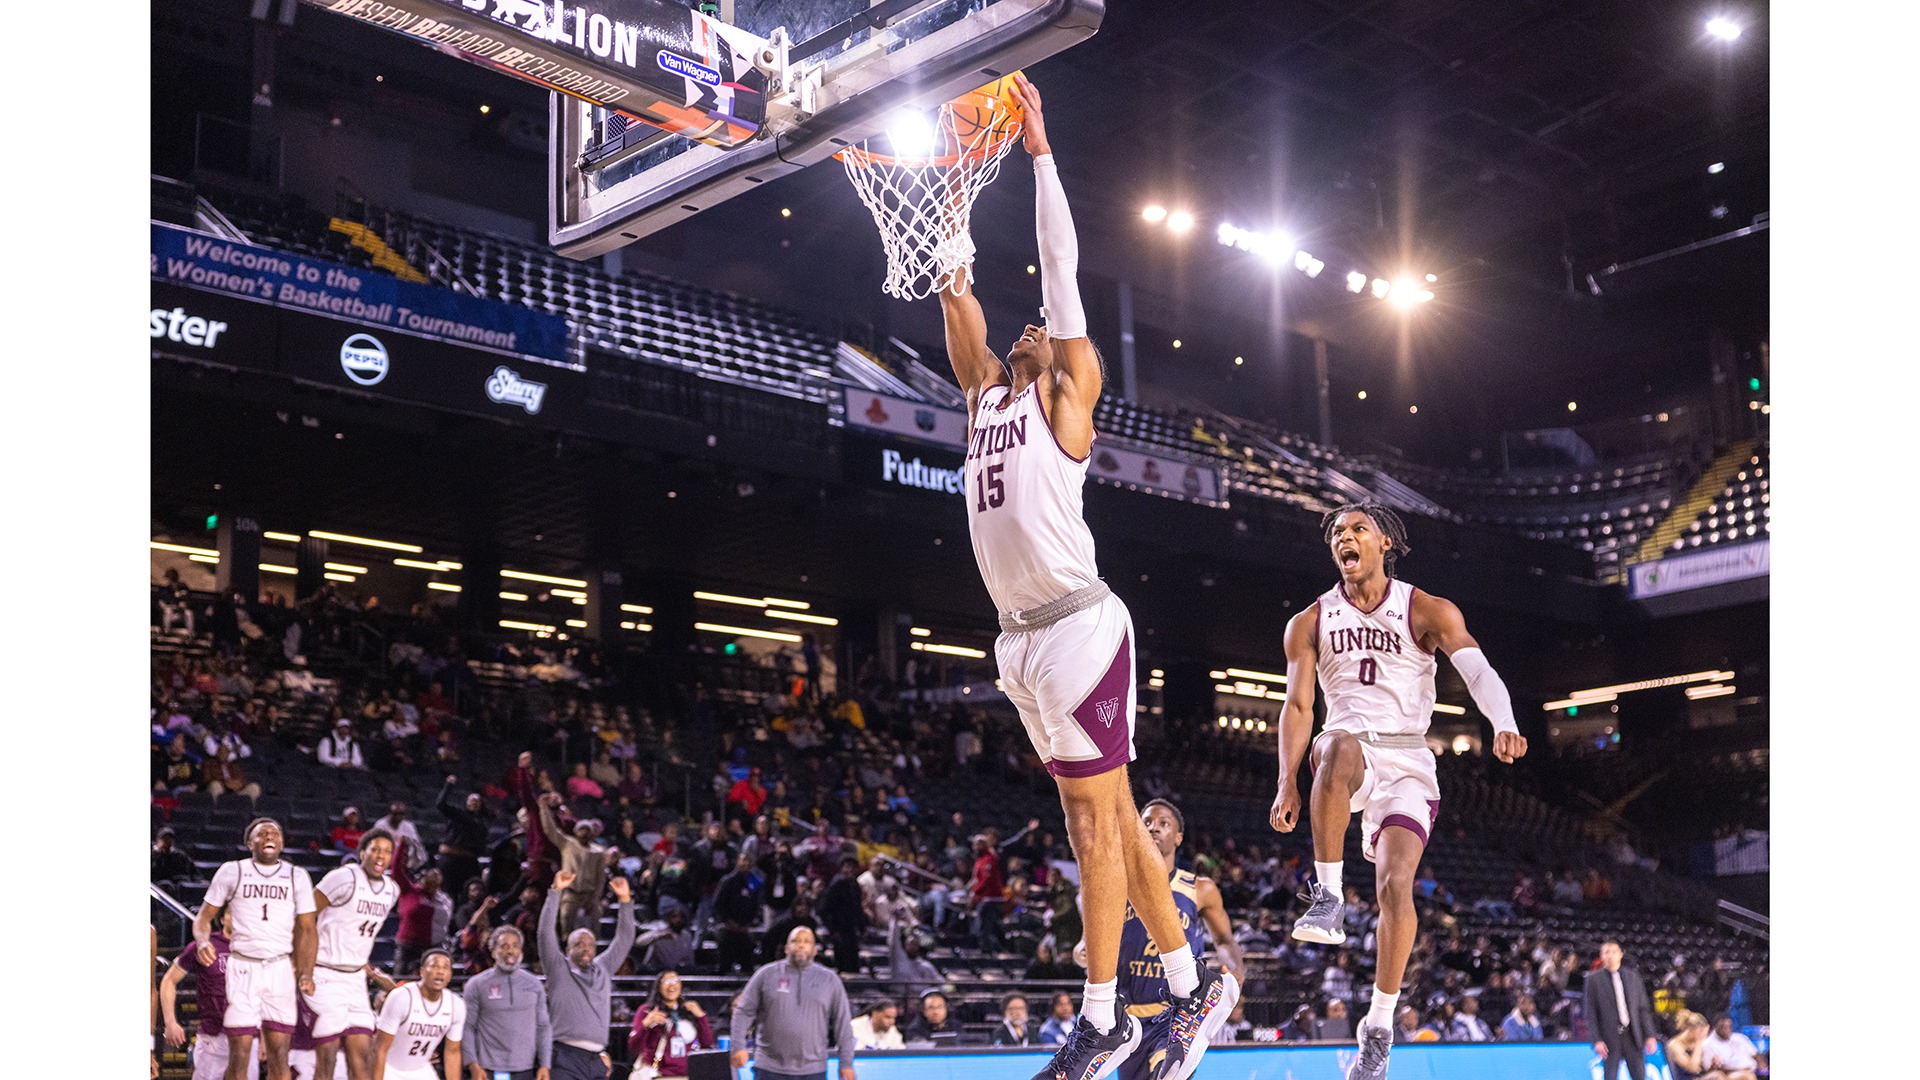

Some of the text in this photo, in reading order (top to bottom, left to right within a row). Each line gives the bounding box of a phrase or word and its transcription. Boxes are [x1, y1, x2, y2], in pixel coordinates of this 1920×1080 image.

[553, 0, 638, 68] LION
[661, 52, 718, 83] Van Wagner
[186, 236, 291, 277] Welcome
[296, 262, 321, 283] to
[326, 268, 361, 292] the
[167, 257, 274, 298] Women's
[278, 282, 393, 323] Basketball
[397, 307, 517, 348] Tournament
[345, 352, 383, 366] PEPSI
[486, 366, 547, 414] Starry
[976, 463, 1006, 513] 15
[1329, 627, 1402, 654] UNION
[1359, 657, 1376, 686] 0
[242, 884, 289, 901] UNION
[261, 903, 269, 921] 1
[356, 899, 390, 917] UNION
[358, 920, 379, 938] 44
[1129, 960, 1168, 979] STAT
[408, 1021, 447, 1038] UNION
[408, 1040, 432, 1057] 24
